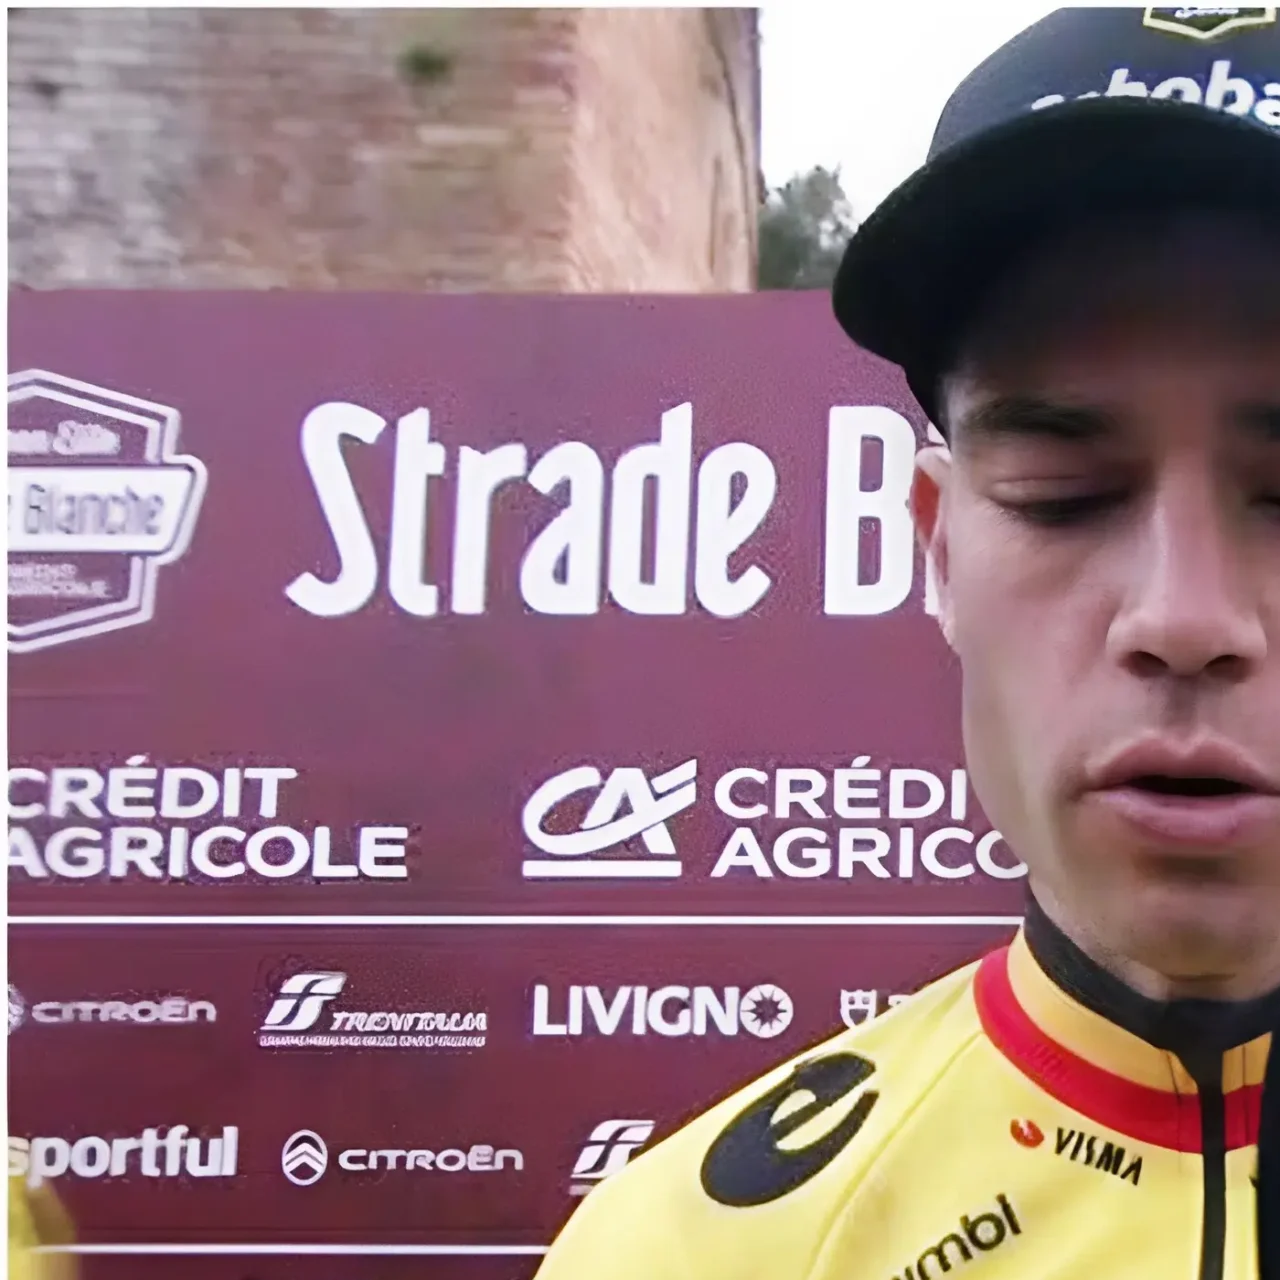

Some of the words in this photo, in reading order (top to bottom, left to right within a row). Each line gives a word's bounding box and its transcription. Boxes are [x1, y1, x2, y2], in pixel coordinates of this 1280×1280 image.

[285, 402, 777, 617] Strade
[8, 756, 298, 819] CRÉDIT
[714, 756, 967, 821] CRÉDI
[8, 826, 408, 879] AGRICOLE
[710, 826, 1029, 879] AGRICO
[1055, 1127, 1144, 1186] VISMA
